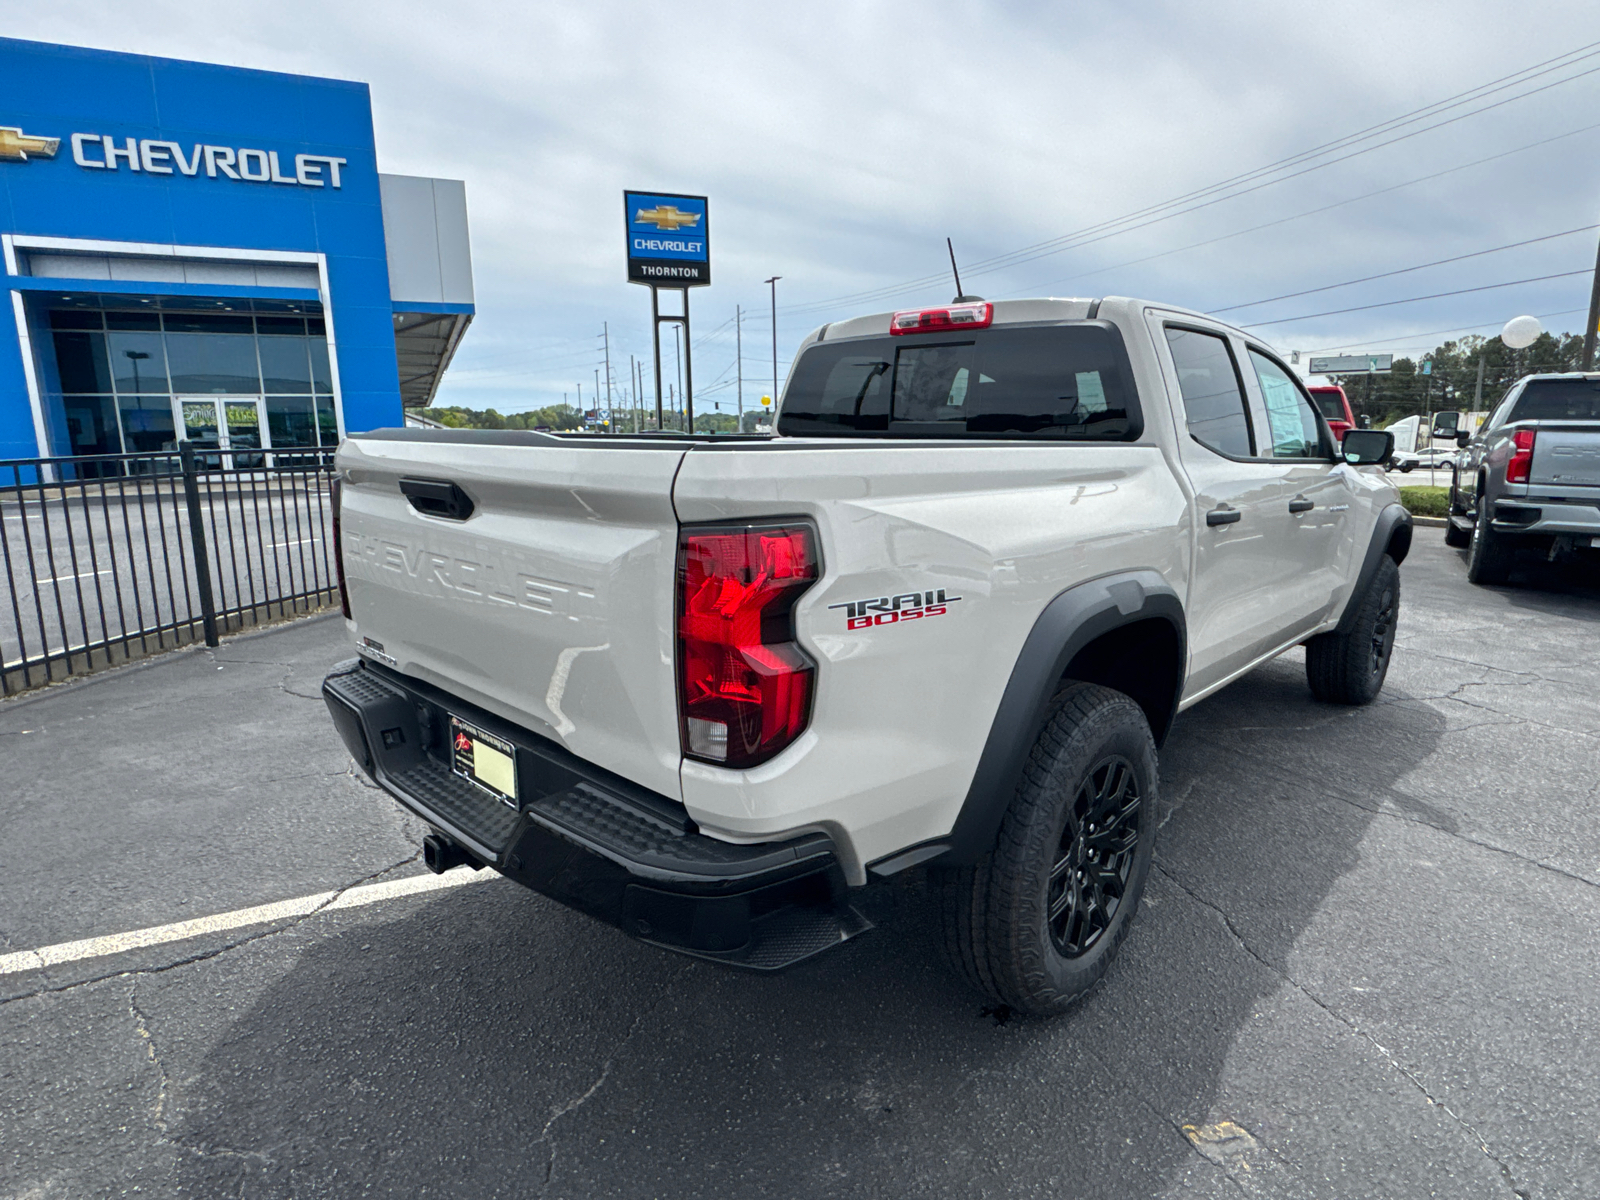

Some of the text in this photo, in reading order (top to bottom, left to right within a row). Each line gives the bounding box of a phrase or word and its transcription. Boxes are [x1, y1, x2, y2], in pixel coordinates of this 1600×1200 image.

[71, 133, 347, 188] CHEVROLET
[634, 239, 702, 252] CHEVROLET
[641, 265, 699, 278] THORNTON
[828, 588, 962, 618] TRAIL
[847, 604, 947, 631] BOSS
